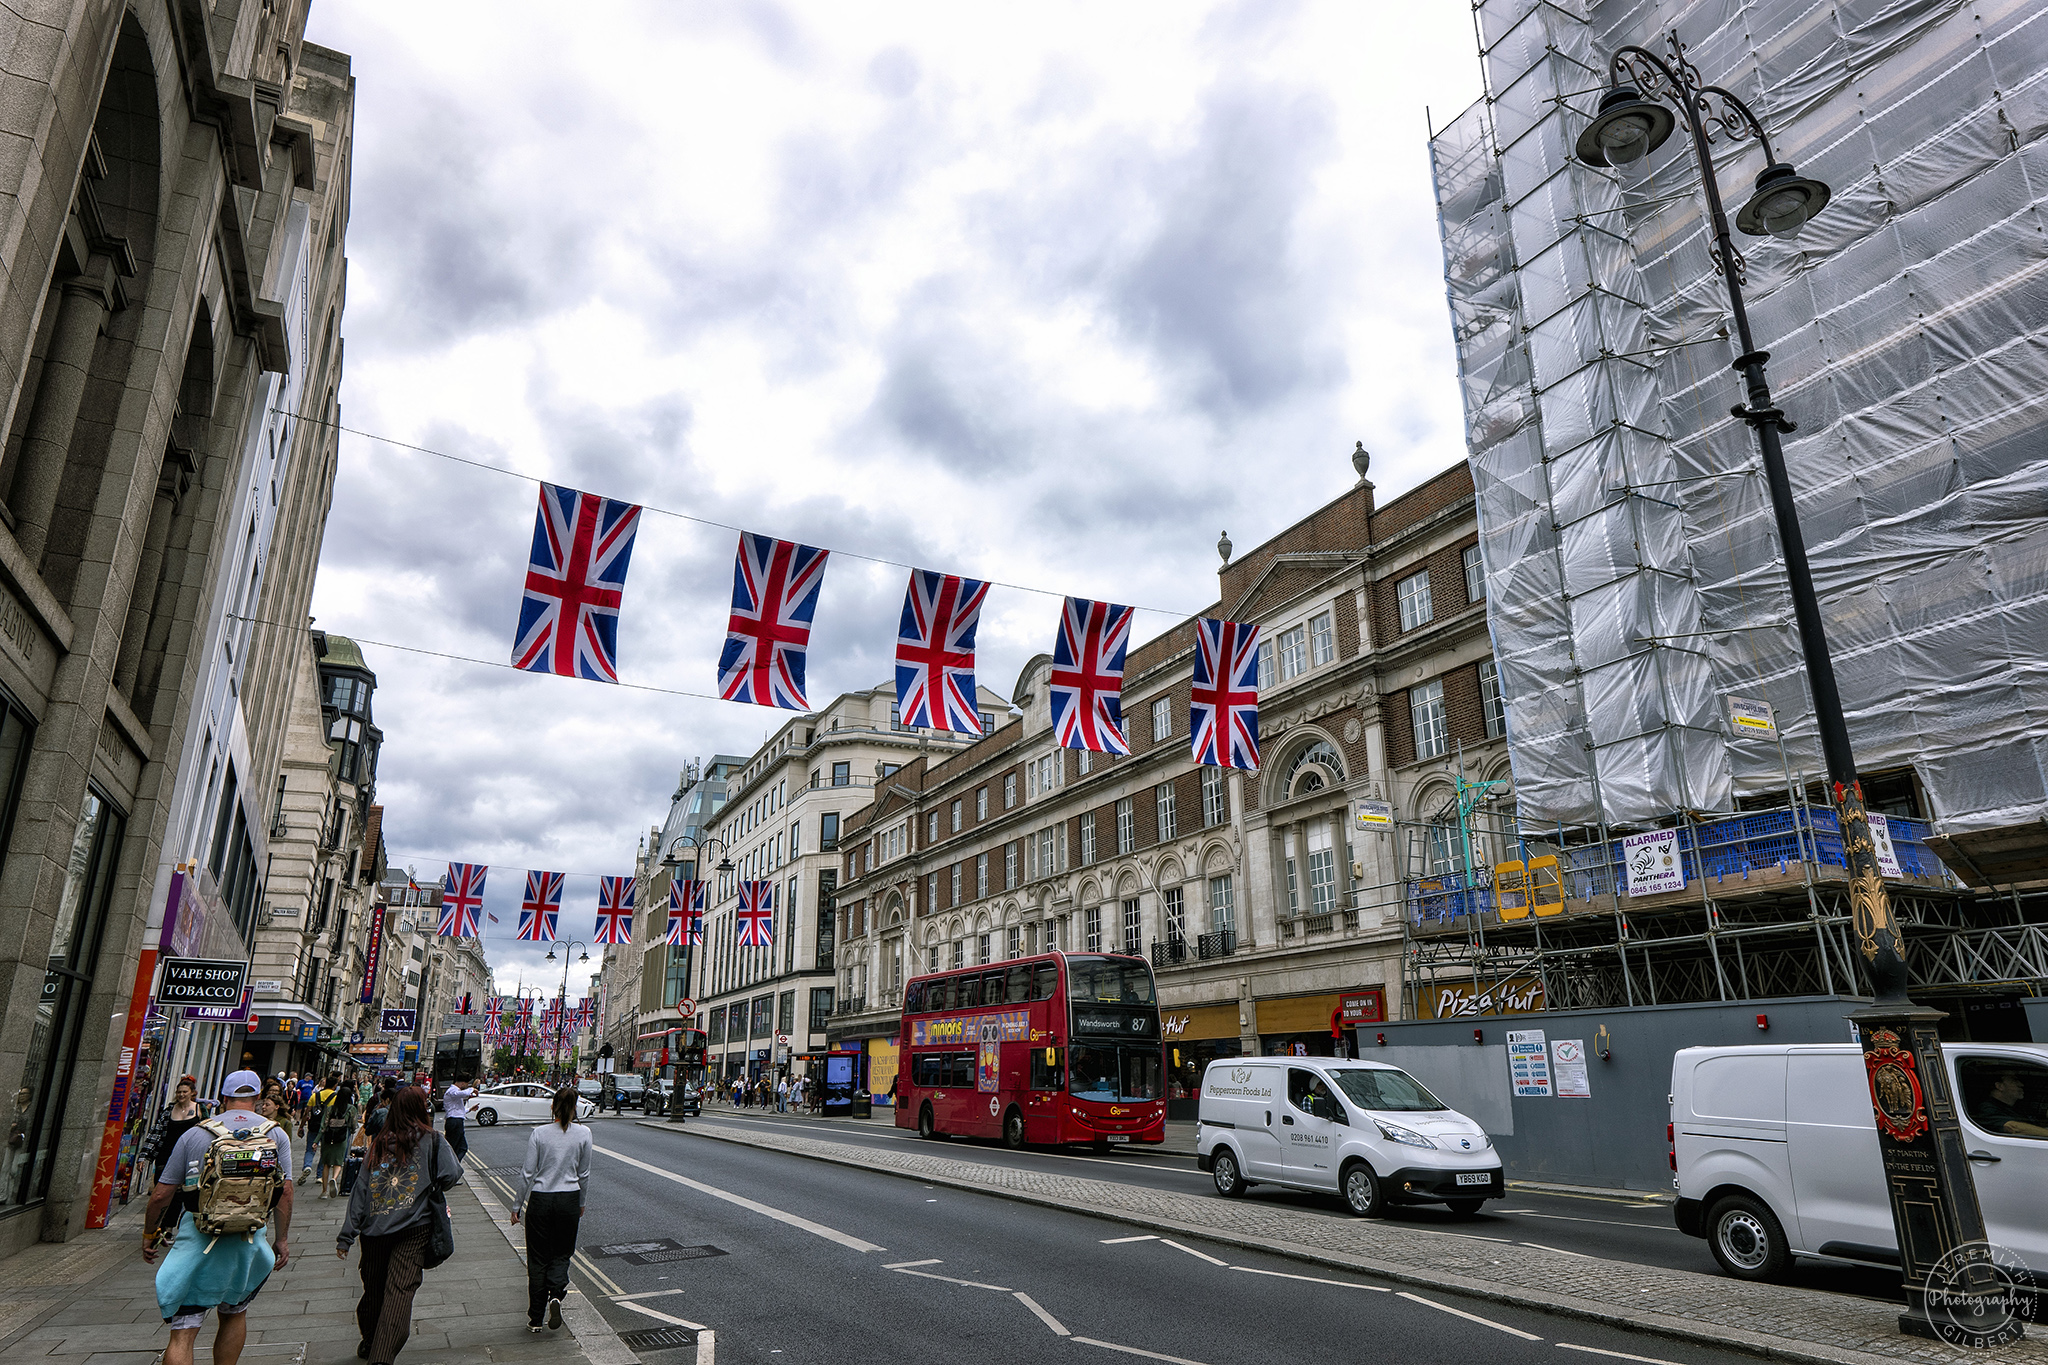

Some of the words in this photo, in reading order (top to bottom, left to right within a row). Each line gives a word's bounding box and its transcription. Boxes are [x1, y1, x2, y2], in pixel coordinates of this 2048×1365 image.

[1626, 831, 1674, 848] ALARMED
[1634, 872, 1675, 883] PANTHERA
[1631, 886, 1647, 894] 0845
[1664, 881, 1681, 889] 1234
[171, 967, 203, 979] VAPE
[204, 969, 238, 980] SHOP
[166, 984, 235, 998] TOBACCO
[1498, 984, 1543, 1011] Hut
[1079, 1018, 1120, 1028] Wandsworth
[1132, 1018, 1146, 1031] 87
[117, 1046, 134, 1075] CANDY
[1209, 1085, 1242, 1095] Peppercorn
[1242, 1086, 1260, 1096] Foods
[1261, 1088, 1271, 1096] Ltd
[108, 1077, 128, 1121] AMERICAN
[1291, 1133, 1303, 1141] 0208
[1315, 1136, 1328, 1144] 4410
[1910, 1164, 1935, 1172] FIELDS
[1460, 1175, 1475, 1183] YB69
